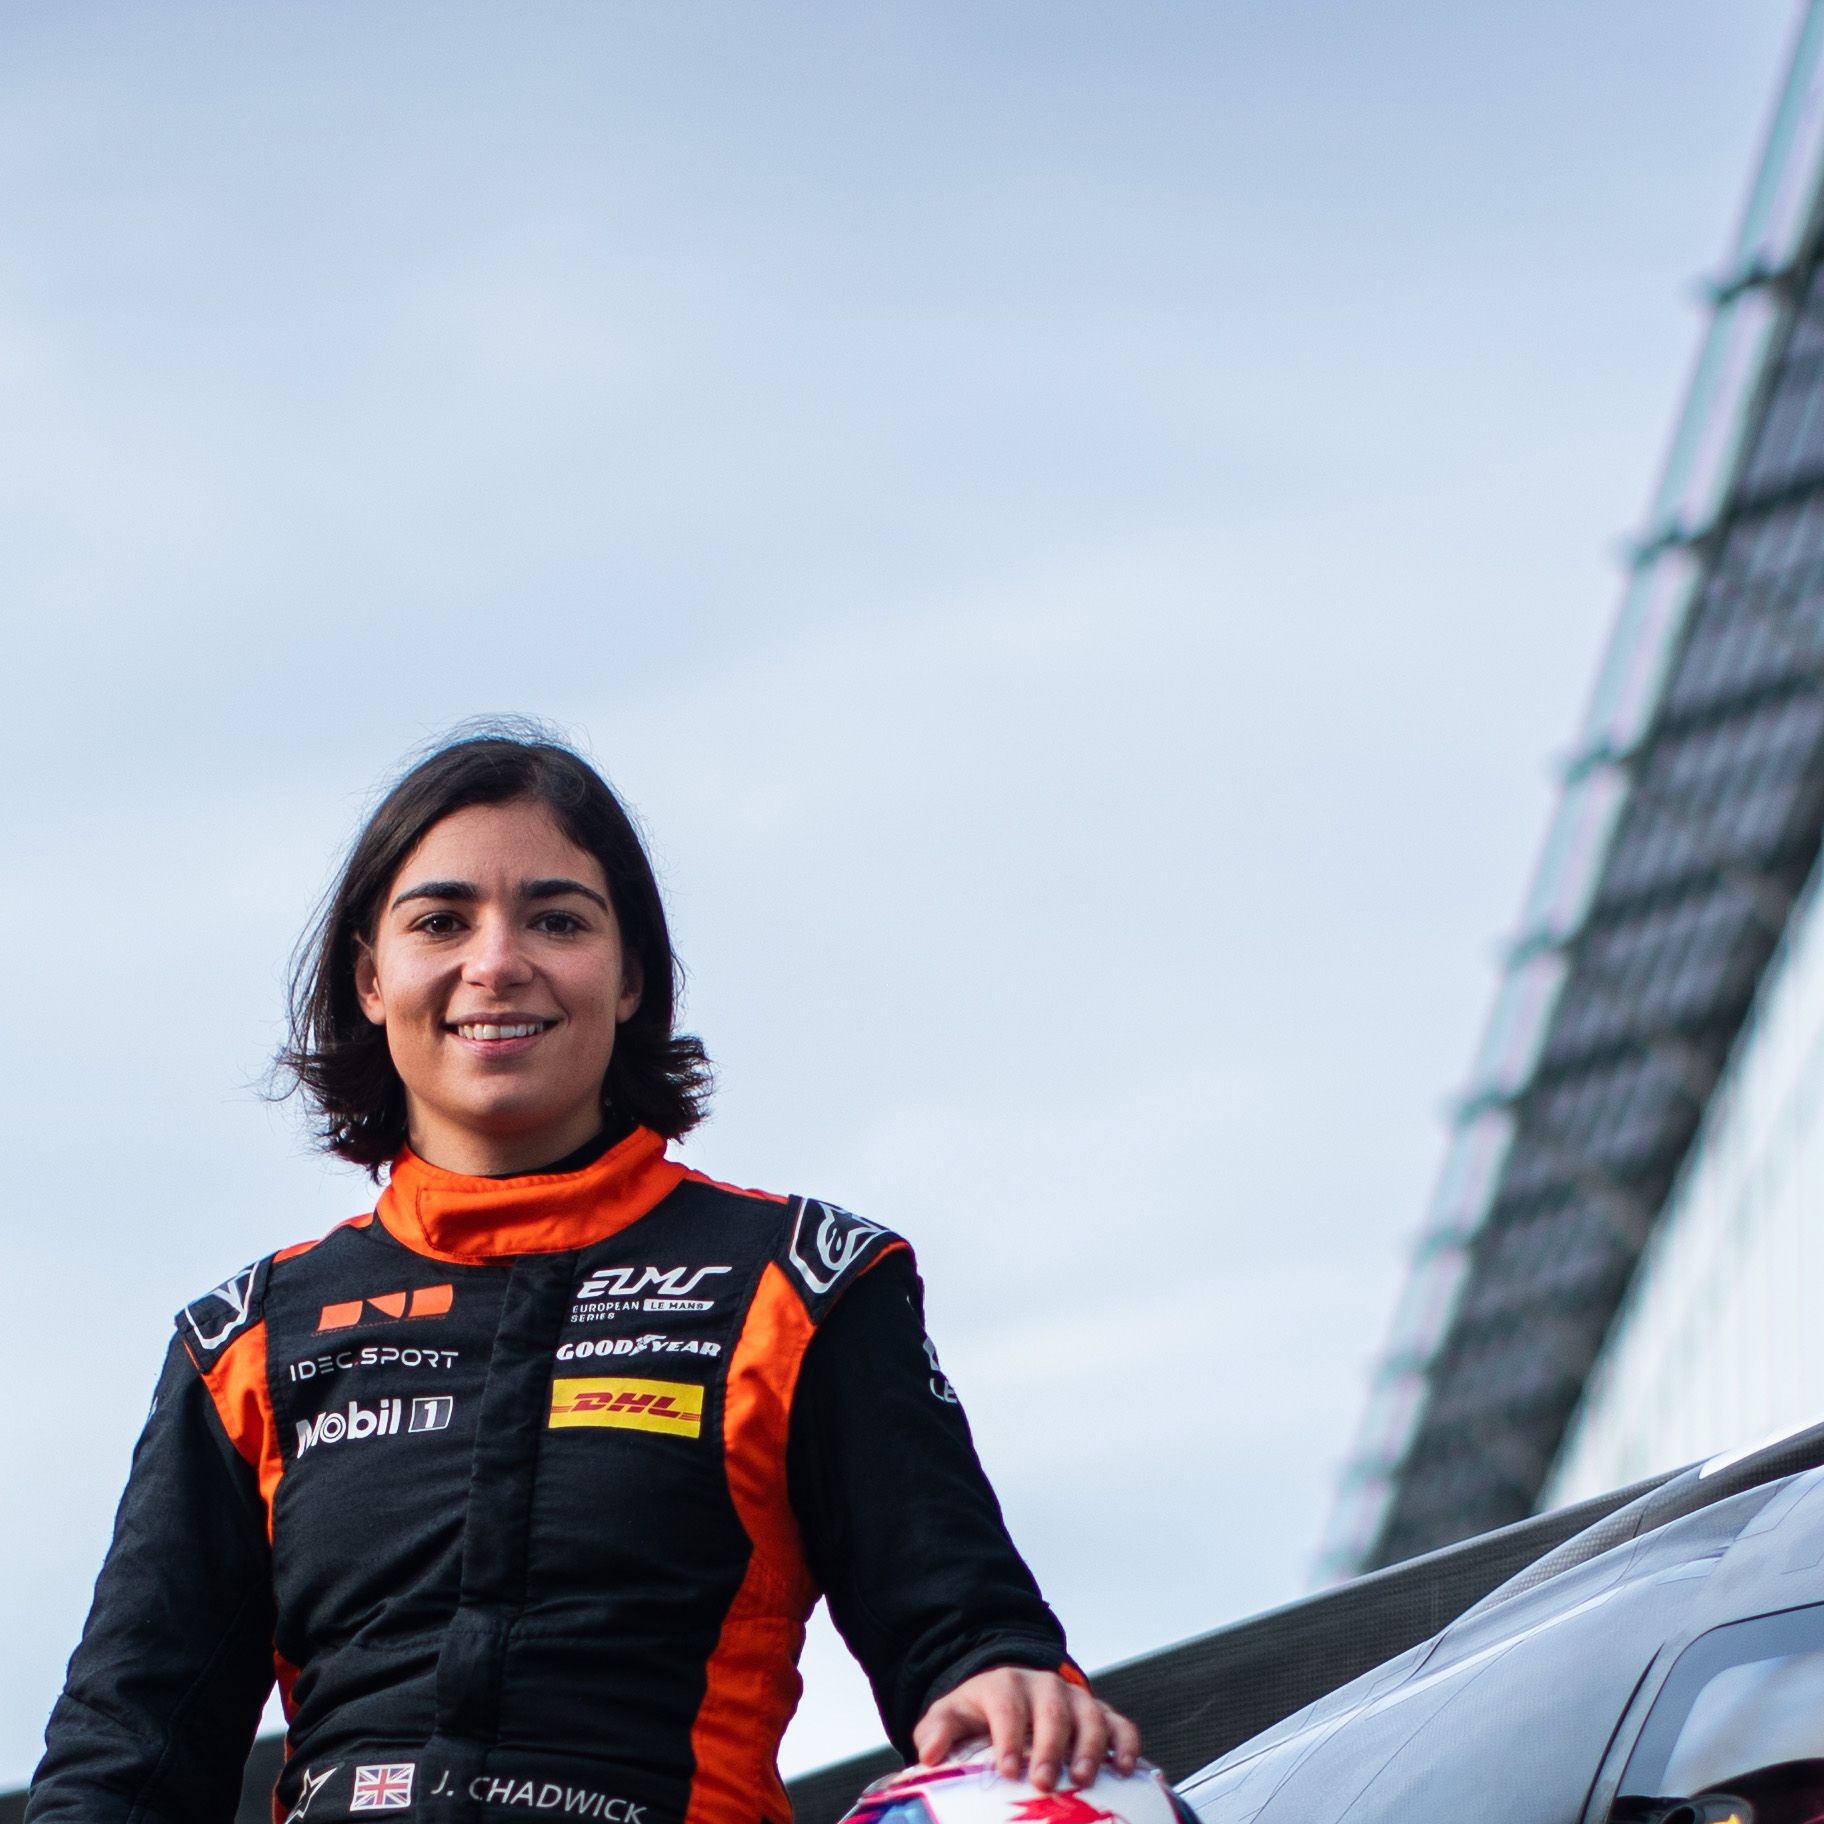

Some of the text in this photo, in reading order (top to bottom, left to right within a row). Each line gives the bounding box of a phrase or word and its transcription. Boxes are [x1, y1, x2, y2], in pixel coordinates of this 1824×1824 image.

[569, 1311, 616, 1324] SERIES
[571, 1300, 705, 1314] EUROPEAN LE MANS
[569, 1391, 682, 1419] DHL
[295, 1398, 402, 1460] Mobil
[429, 1769, 455, 1797] J.
